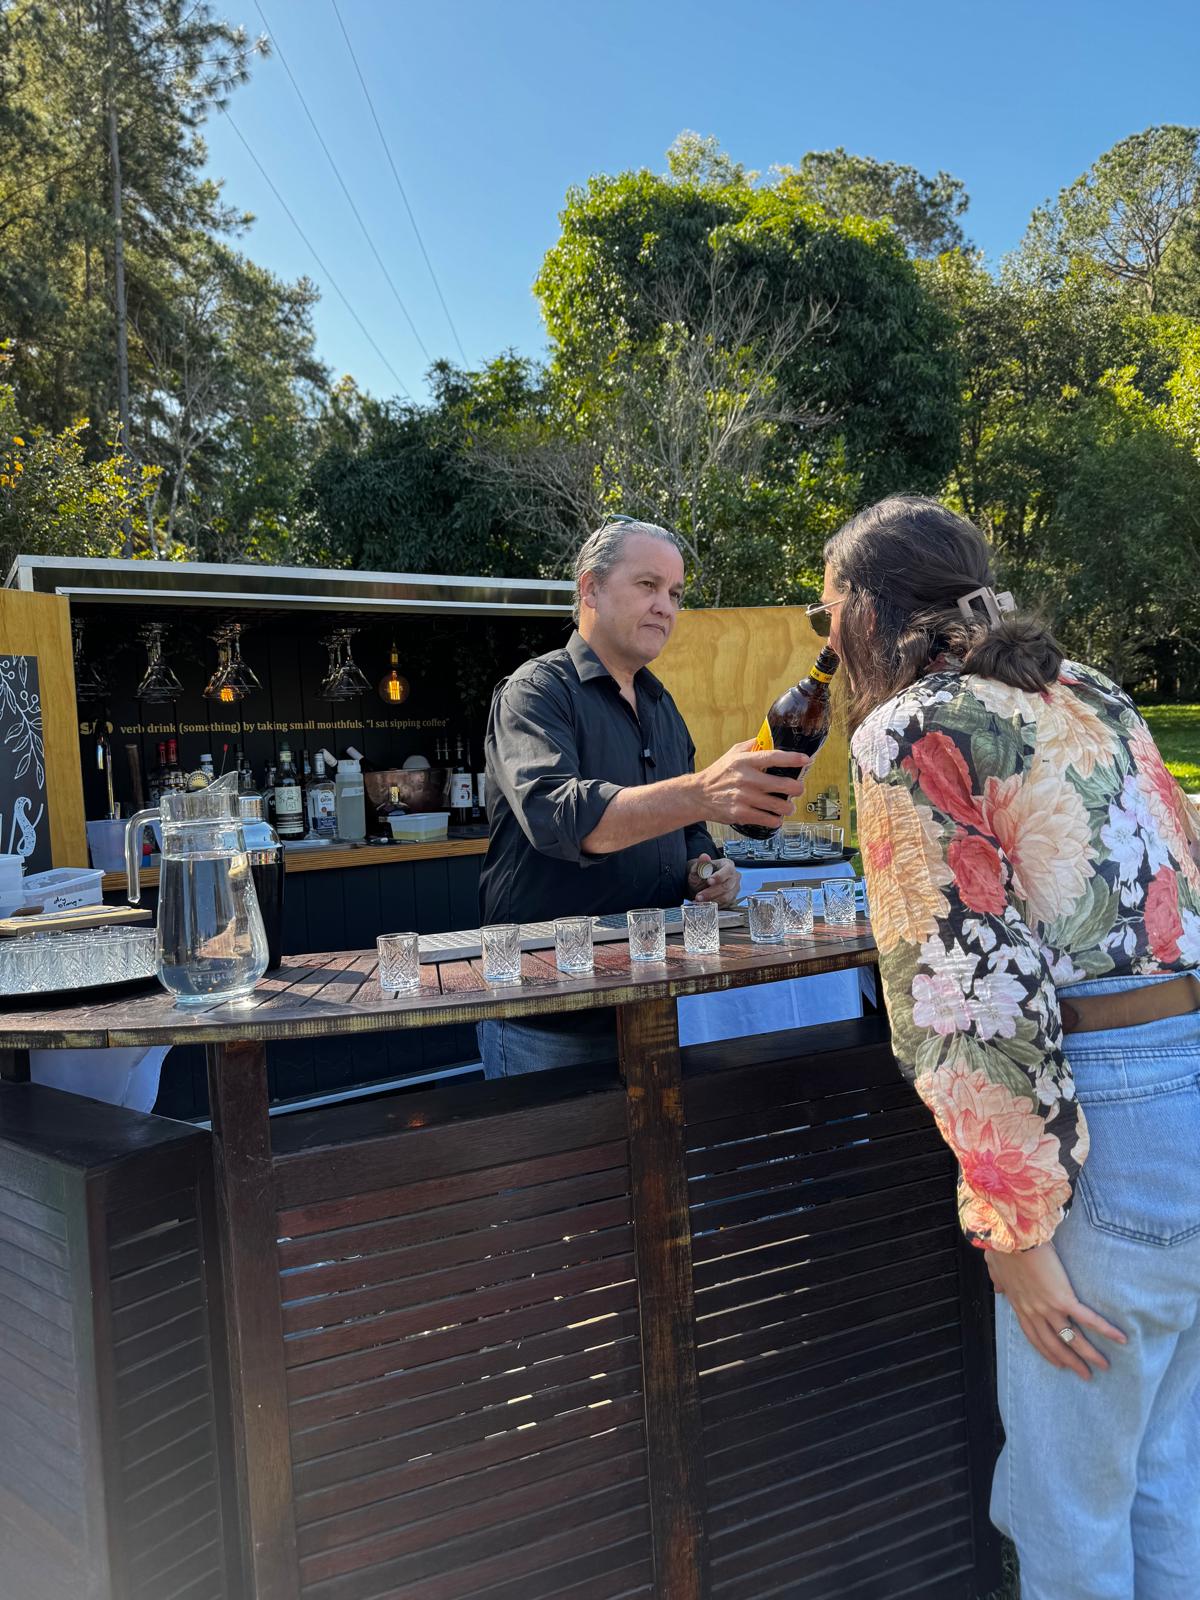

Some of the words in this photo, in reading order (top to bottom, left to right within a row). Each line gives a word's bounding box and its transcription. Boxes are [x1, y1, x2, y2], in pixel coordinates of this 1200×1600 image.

[120, 724, 144, 734] verb
[147, 722, 176, 734] drink
[179, 722, 241, 735] (something)
[243, 721, 255, 732] by
[257, 720, 288, 733] taking
[290, 720, 315, 731] small
[317, 719, 365, 729] mouthfuls.
[375, 720, 388, 728] sat
[390, 718, 420, 730] sipping
